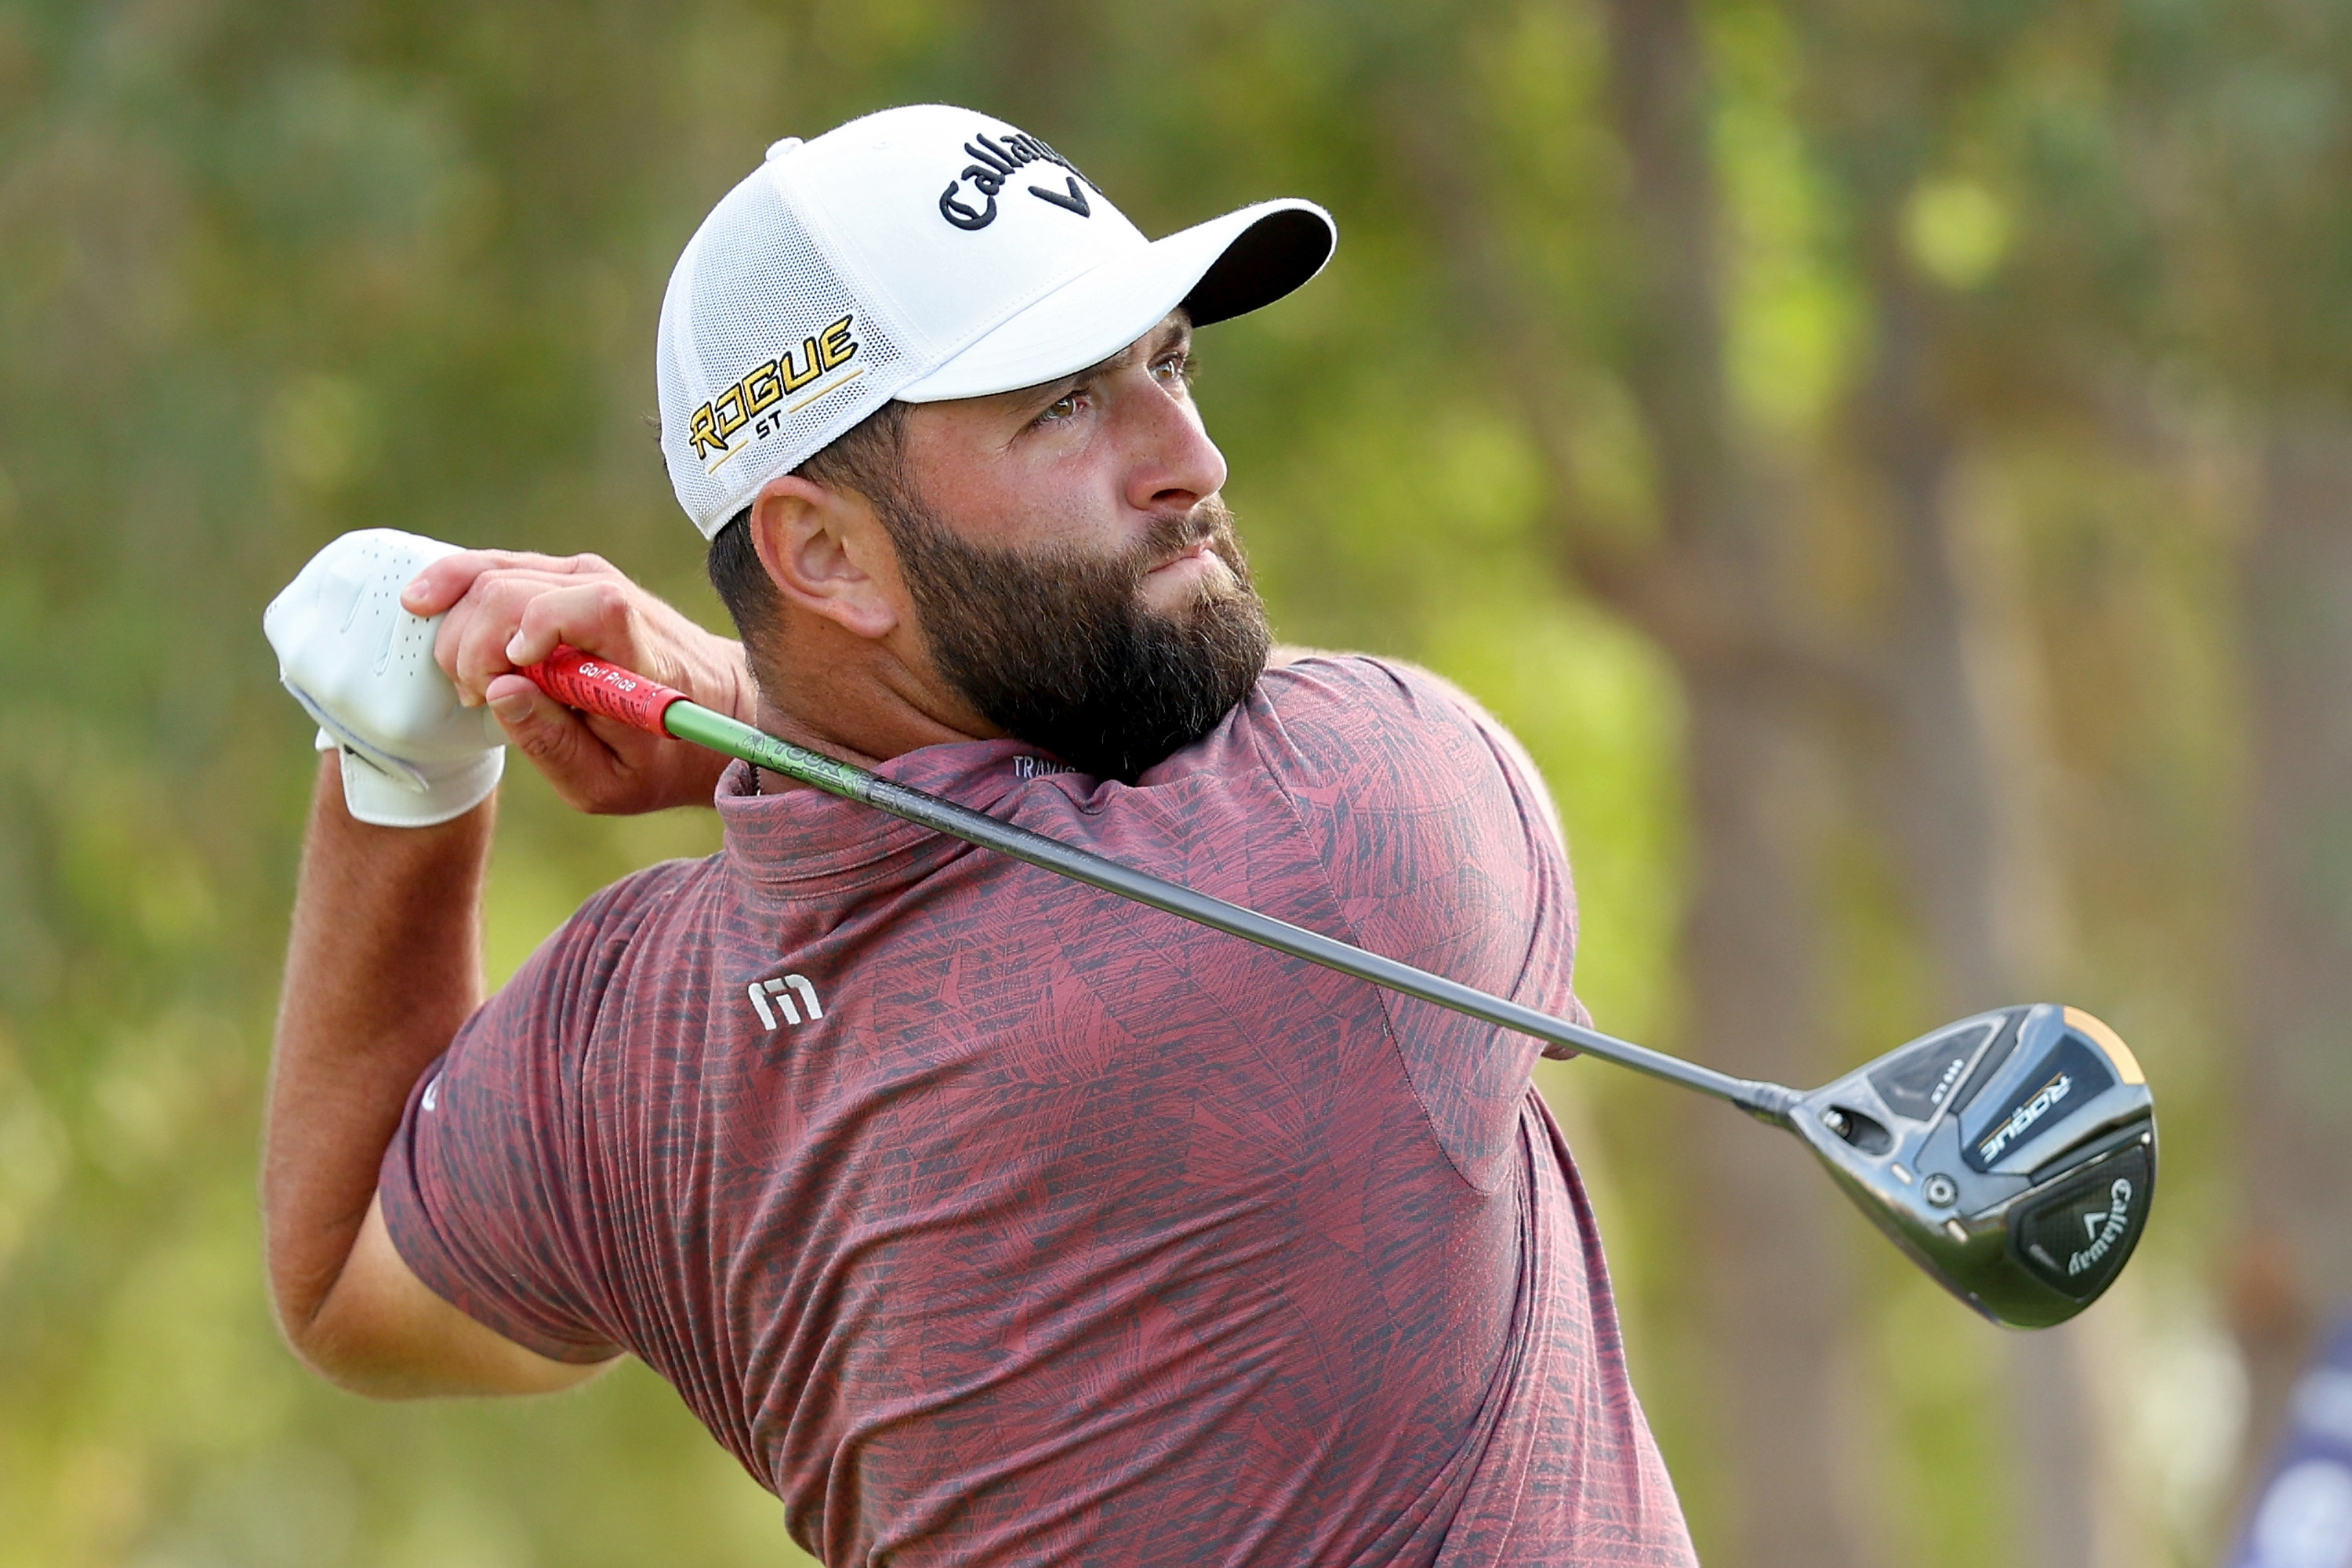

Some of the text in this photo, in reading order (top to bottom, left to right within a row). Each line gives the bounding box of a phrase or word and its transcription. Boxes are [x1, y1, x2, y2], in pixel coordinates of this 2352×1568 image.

[689, 314, 859, 460] ROGUE
[755, 409, 782, 440] ST
[579, 661, 637, 692] Golf Pride
[1979, 1075, 2072, 1164] ROGUE
[2068, 1178, 2133, 1276] Callaway
